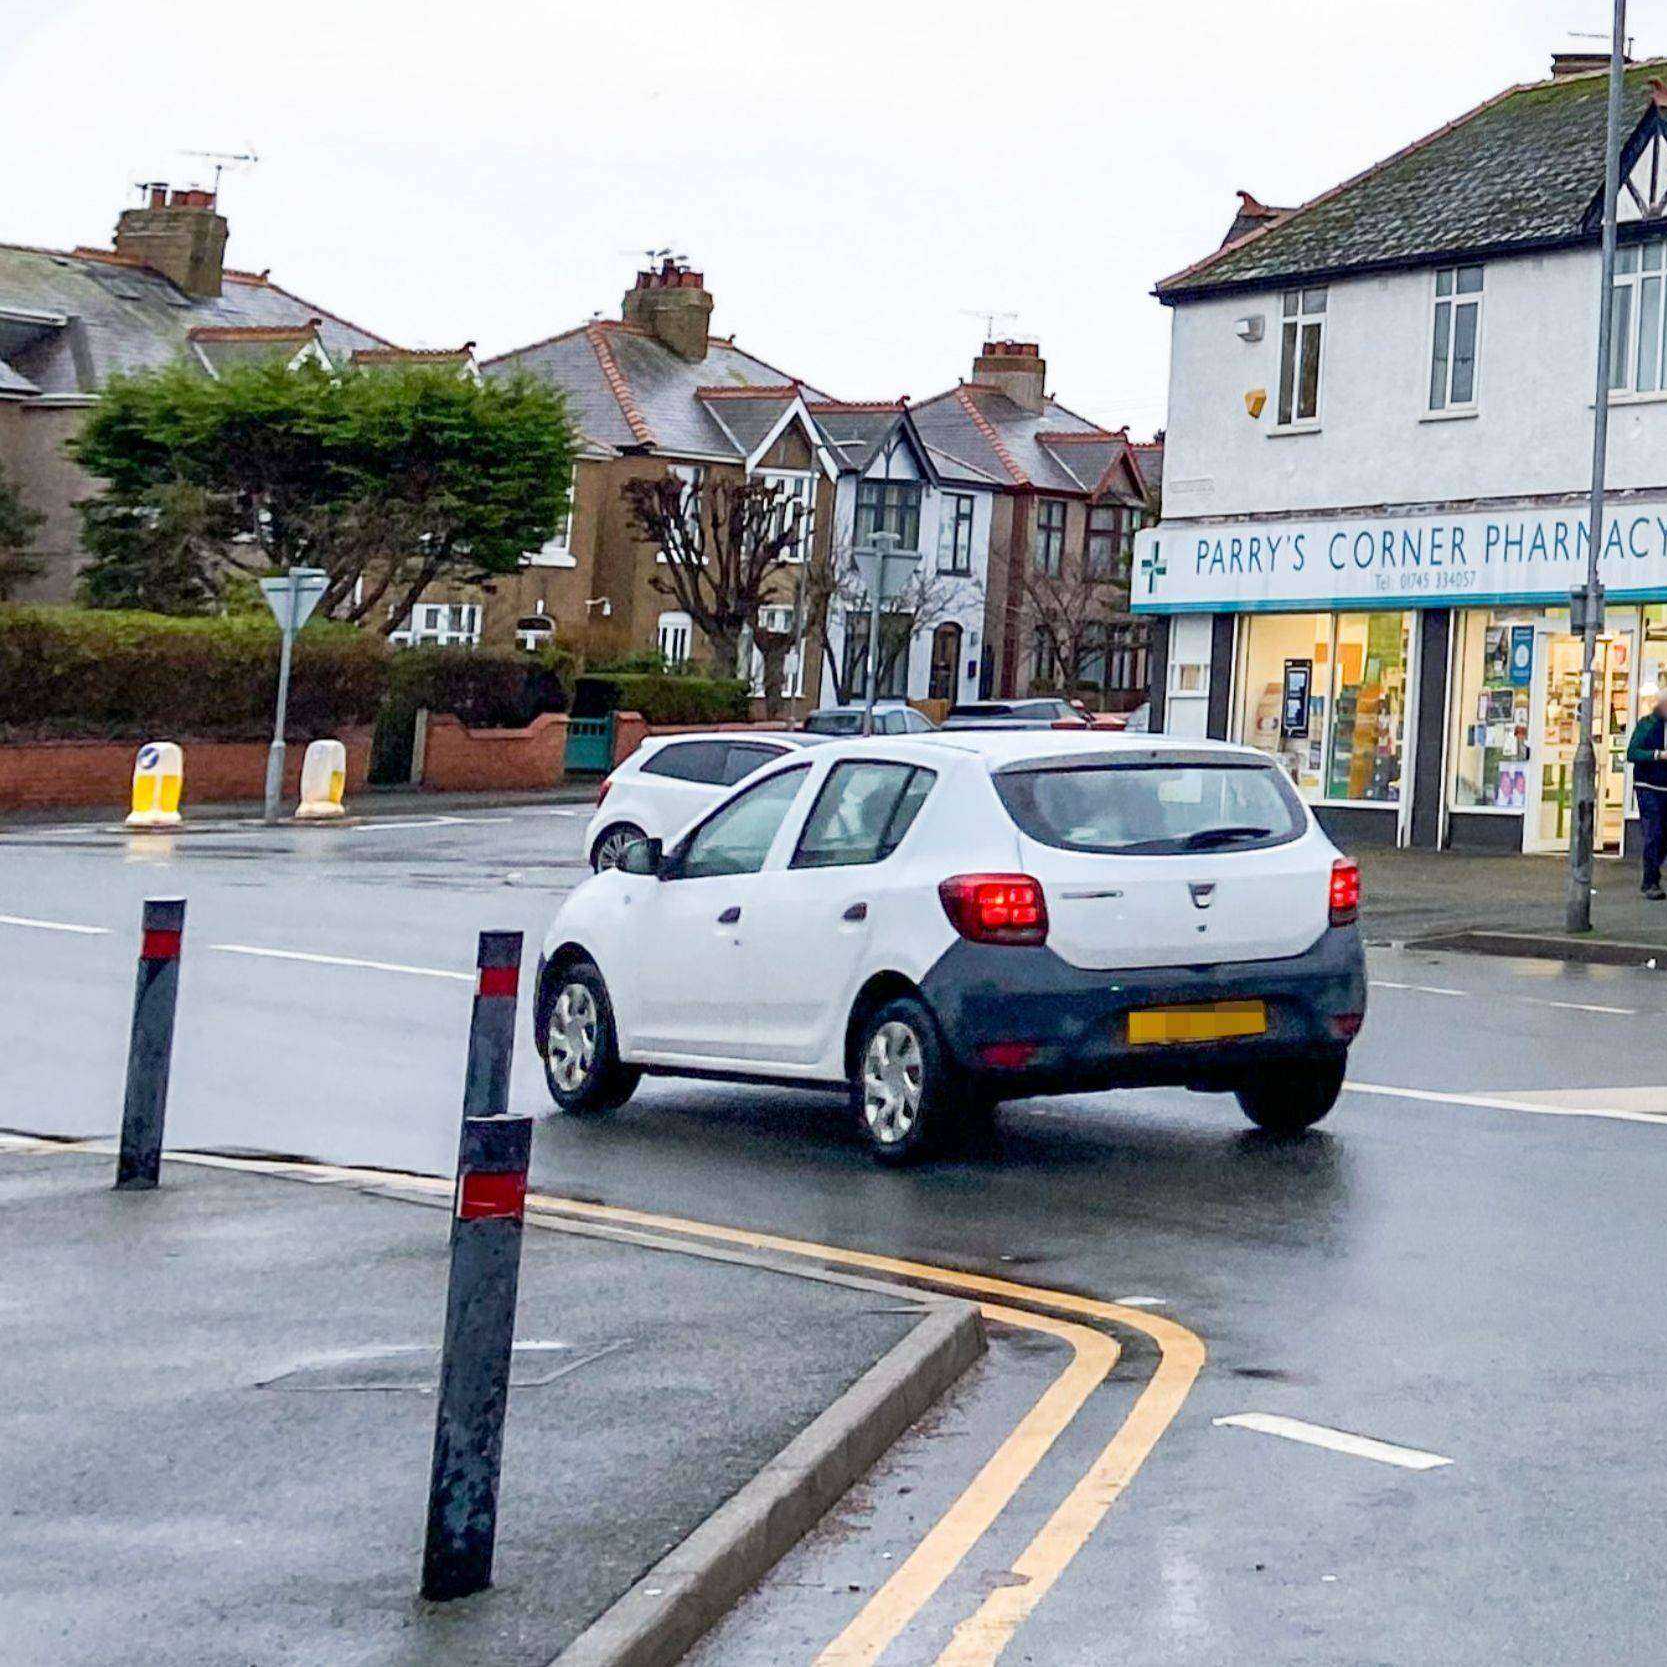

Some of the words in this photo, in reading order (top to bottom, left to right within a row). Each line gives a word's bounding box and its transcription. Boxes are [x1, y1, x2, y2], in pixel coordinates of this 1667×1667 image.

[1196, 533, 1305, 575] PARRY'S
[1328, 527, 1466, 570] CORNER
[1400, 572, 1430, 590] 01745
